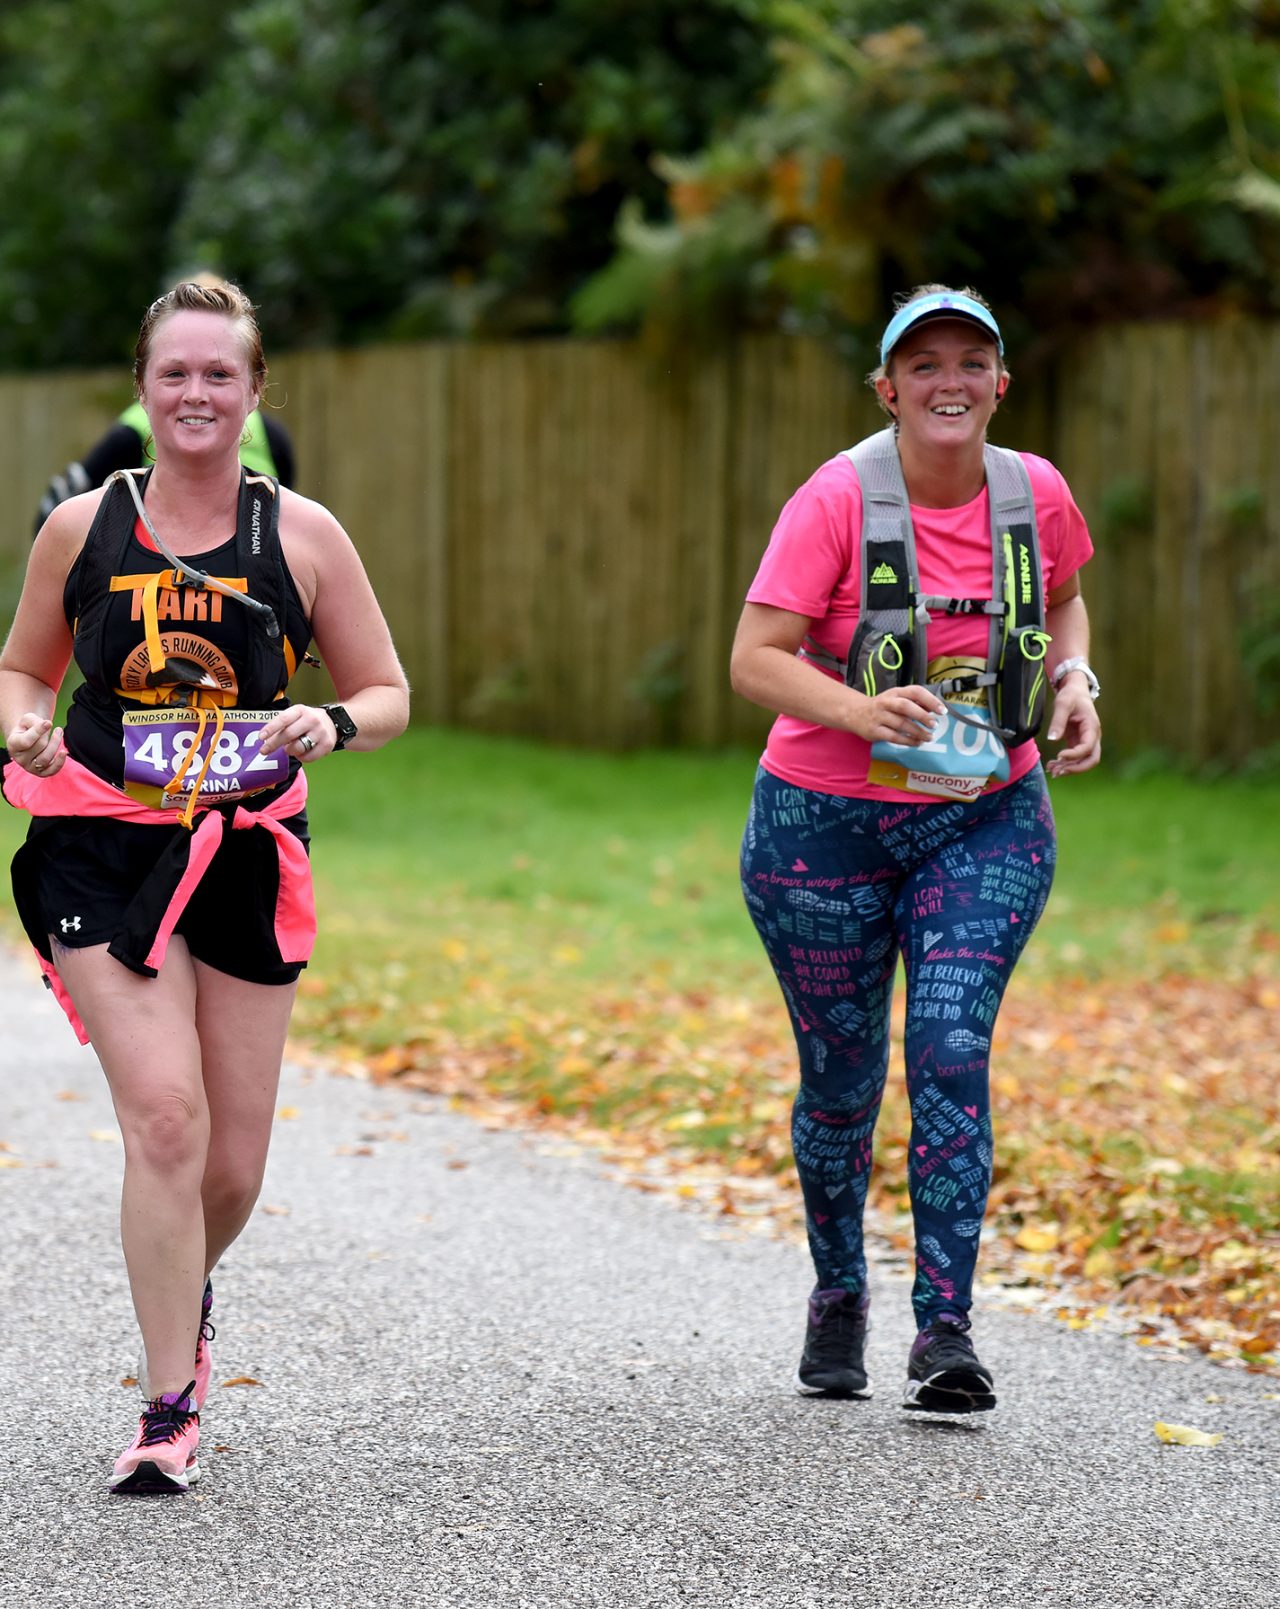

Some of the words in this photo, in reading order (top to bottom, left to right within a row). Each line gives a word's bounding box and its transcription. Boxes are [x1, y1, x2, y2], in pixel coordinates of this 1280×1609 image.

[251, 510, 261, 555] NATHAN
[1019, 543, 1032, 605] AONIJE
[173, 637, 221, 668] RUNNING
[213, 665, 233, 690] CLUB
[128, 712, 174, 724] WINDSOR
[133, 730, 279, 777] 4882
[909, 772, 972, 790] saucony
[779, 807, 811, 827] WILL
[965, 852, 974, 863] A
[1004, 852, 1032, 872] born
[770, 869, 803, 888] brave
[806, 876, 845, 892] wings
[949, 863, 980, 879] TIME
[920, 884, 944, 903] CAN
[919, 898, 945, 918] WILL
[808, 947, 863, 964] BELIEVED
[924, 948, 956, 964] Make
[956, 946, 975, 959] the
[813, 966, 851, 982] COULD
[918, 964, 934, 980] SHE
[933, 964, 984, 987] BELIEVED
[836, 982, 857, 997] DID
[915, 983, 930, 999] SHE
[930, 982, 965, 1002] COULD
[923, 1001, 941, 1020] SHE
[942, 1004, 963, 1022] DID
[936, 1061, 966, 1077] born
[938, 1099, 980, 1137] BELIEVED
[808, 1141, 851, 1158] COULD
[823, 1159, 847, 1173] DID
[934, 1176, 963, 1198] CAN
[921, 1189, 952, 1213] WILL
